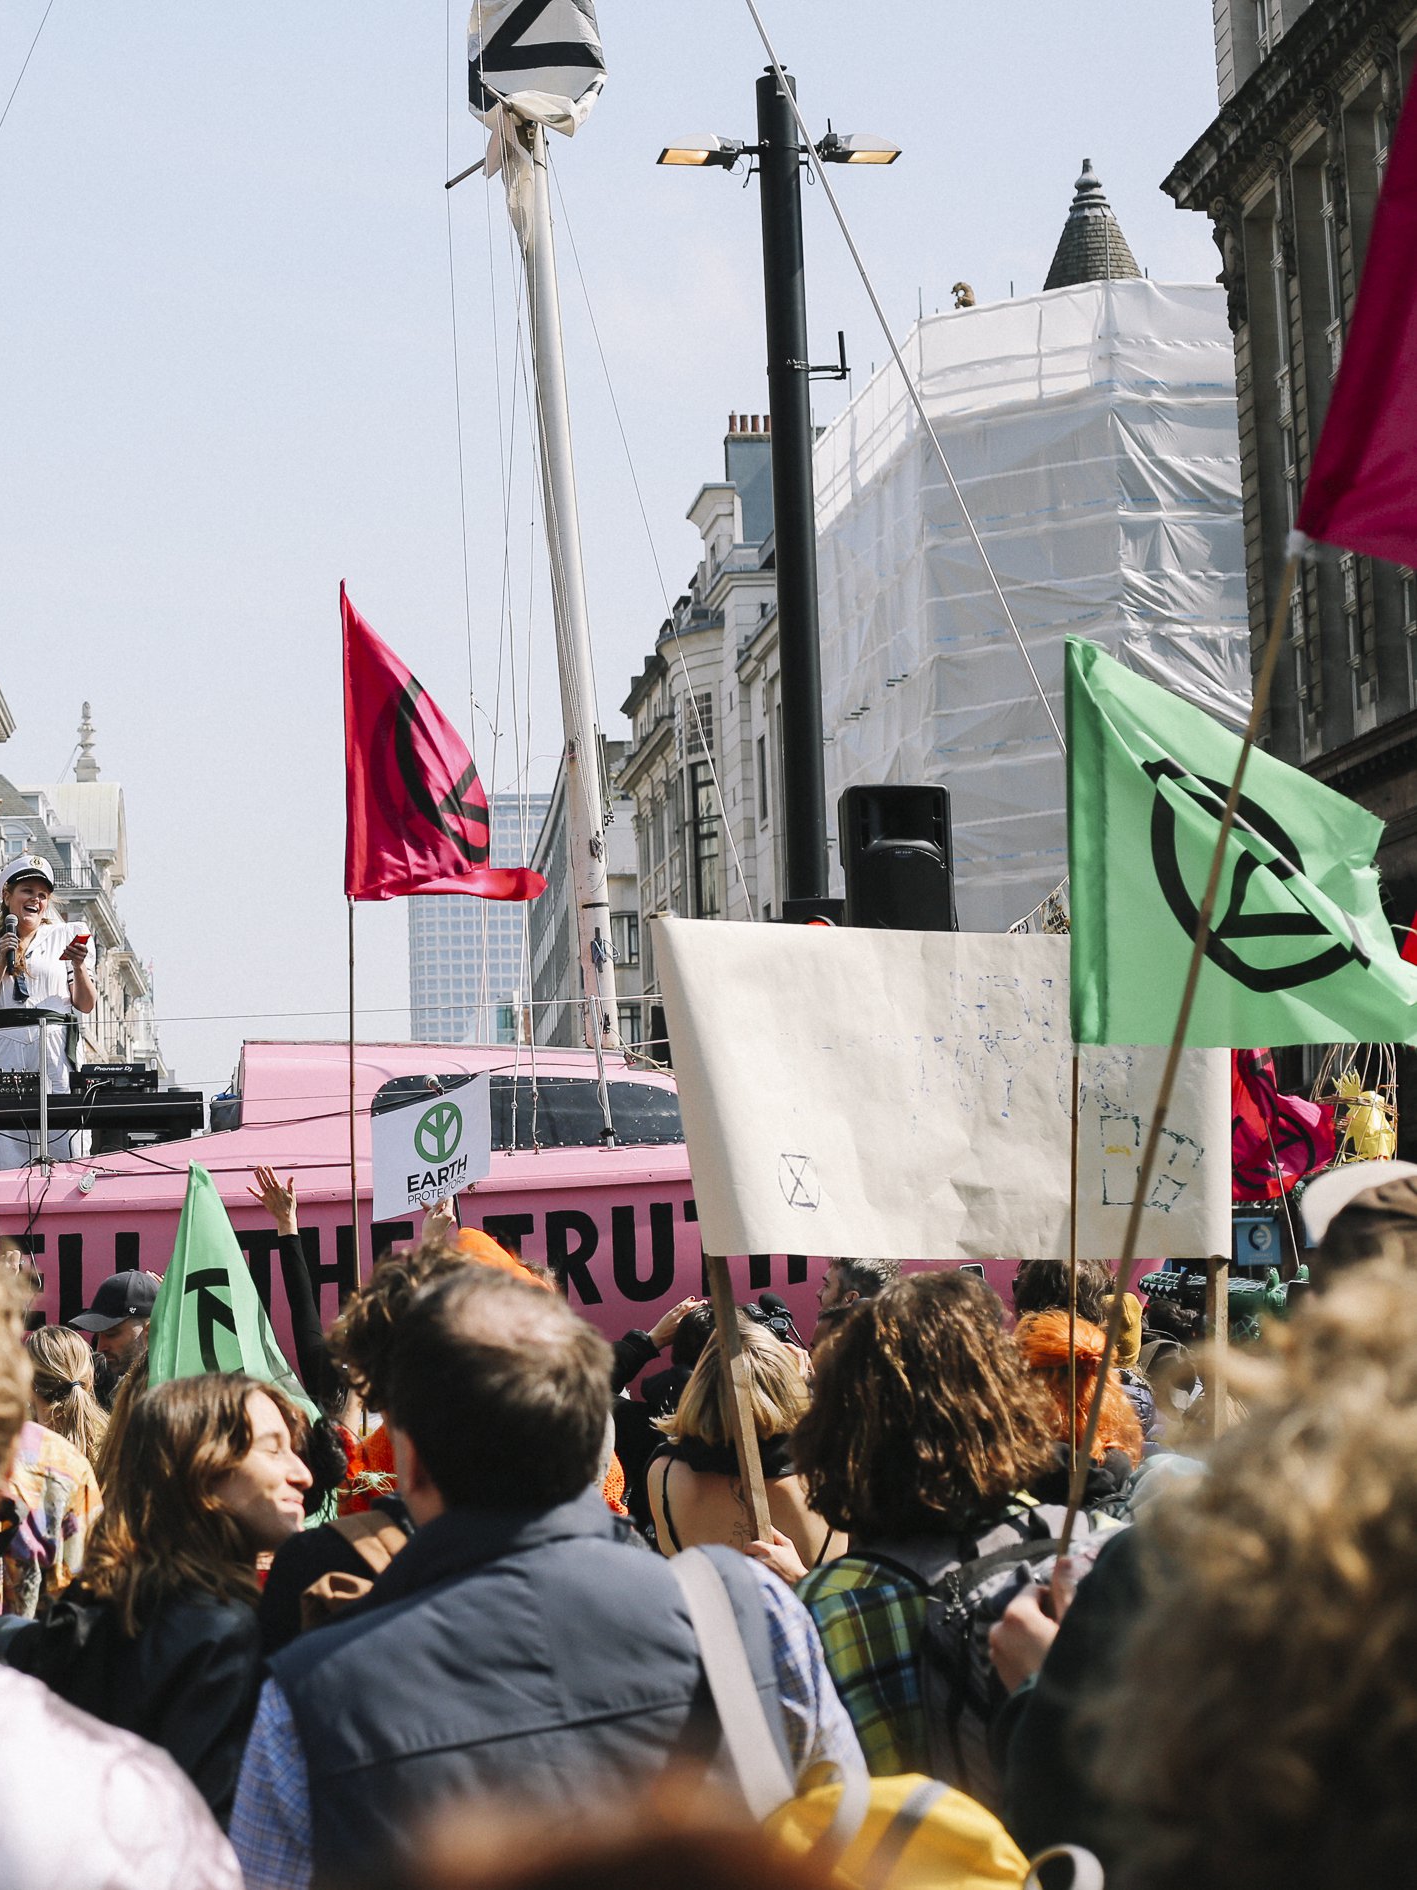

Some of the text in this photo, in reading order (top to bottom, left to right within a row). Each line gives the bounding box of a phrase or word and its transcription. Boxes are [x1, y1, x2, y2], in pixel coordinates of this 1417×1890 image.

[1047, 911, 1067, 927] REBEL
[407, 1153, 468, 1194] EARTH
[407, 1173, 466, 1206] PROTECTORS
[482, 1200, 808, 1306] TRU
